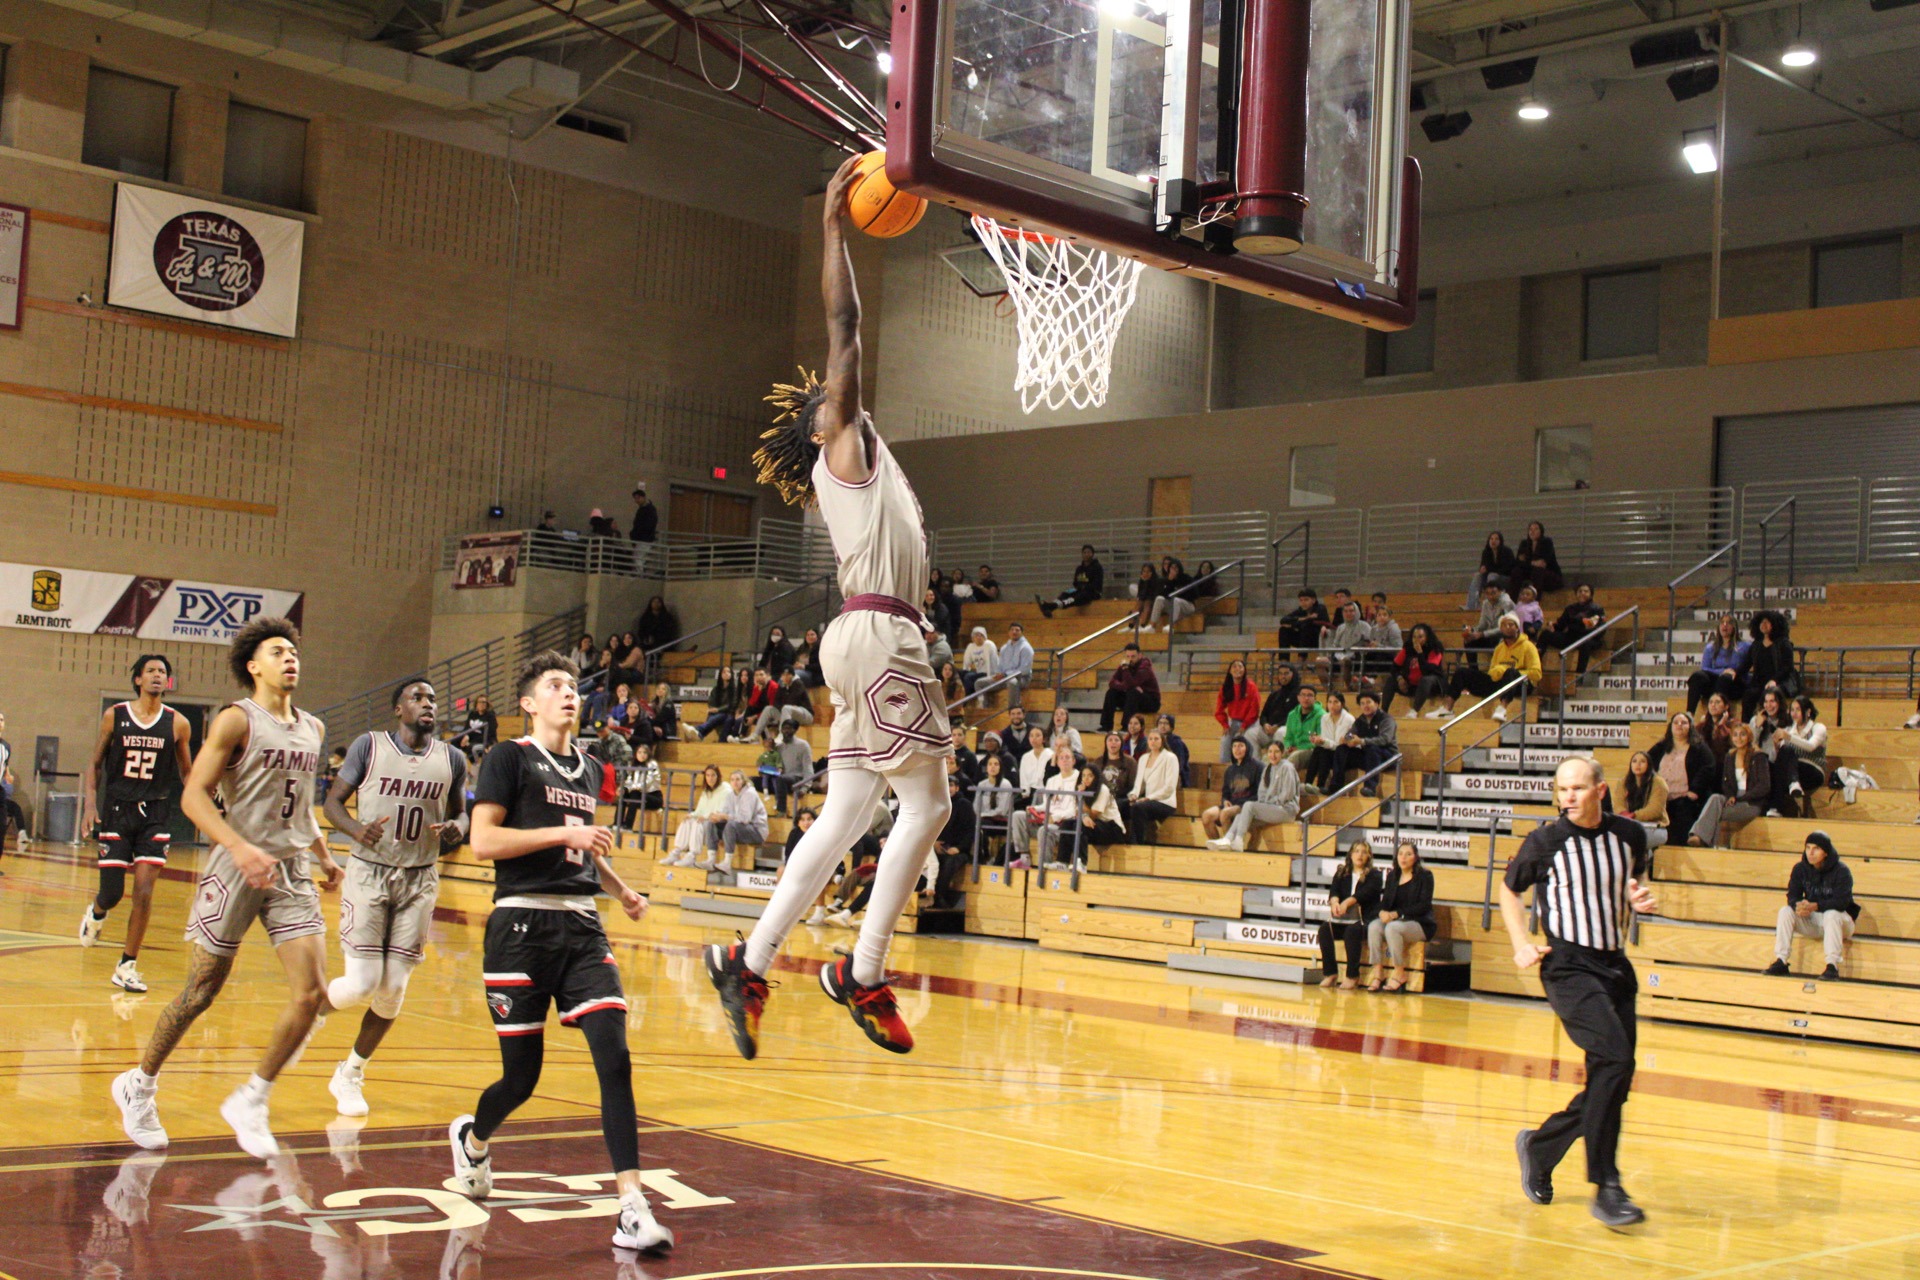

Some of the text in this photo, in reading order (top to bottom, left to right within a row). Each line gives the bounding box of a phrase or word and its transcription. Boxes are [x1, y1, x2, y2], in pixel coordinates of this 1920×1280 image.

[182, 218, 241, 241] TEXAS
[15, 614, 72, 629] ARMY ROTC
[172, 625, 208, 638] PRINT
[1640, 678, 1674, 689] FIGHT!
[1570, 704, 1667, 715] THE PRIDE OF TAMI
[1529, 726, 1557, 736] LET'S
[1576, 728, 1630, 737] DUSTDEVIL
[123, 735, 164, 749] WESTERN
[124, 750, 157, 780] 22
[262, 748, 319, 772] TAMIU
[1524, 754, 1550, 762] LWAYS
[378, 776, 444, 800] TAMIU
[1465, 778, 1554, 791] GO DUSTDEVILS
[281, 778, 298, 819] 5
[545, 785, 597, 815] WESTERN
[394, 803, 424, 844] 10
[1372, 834, 1395, 844] WITH
[1425, 838, 1451, 848] FROM
[1452, 840, 1470, 849] INSI
[749, 876, 777, 887] FOLLOW
[1281, 896, 1302, 904] SOUT
[1242, 926, 1319, 945] GO DUSTDEVI
